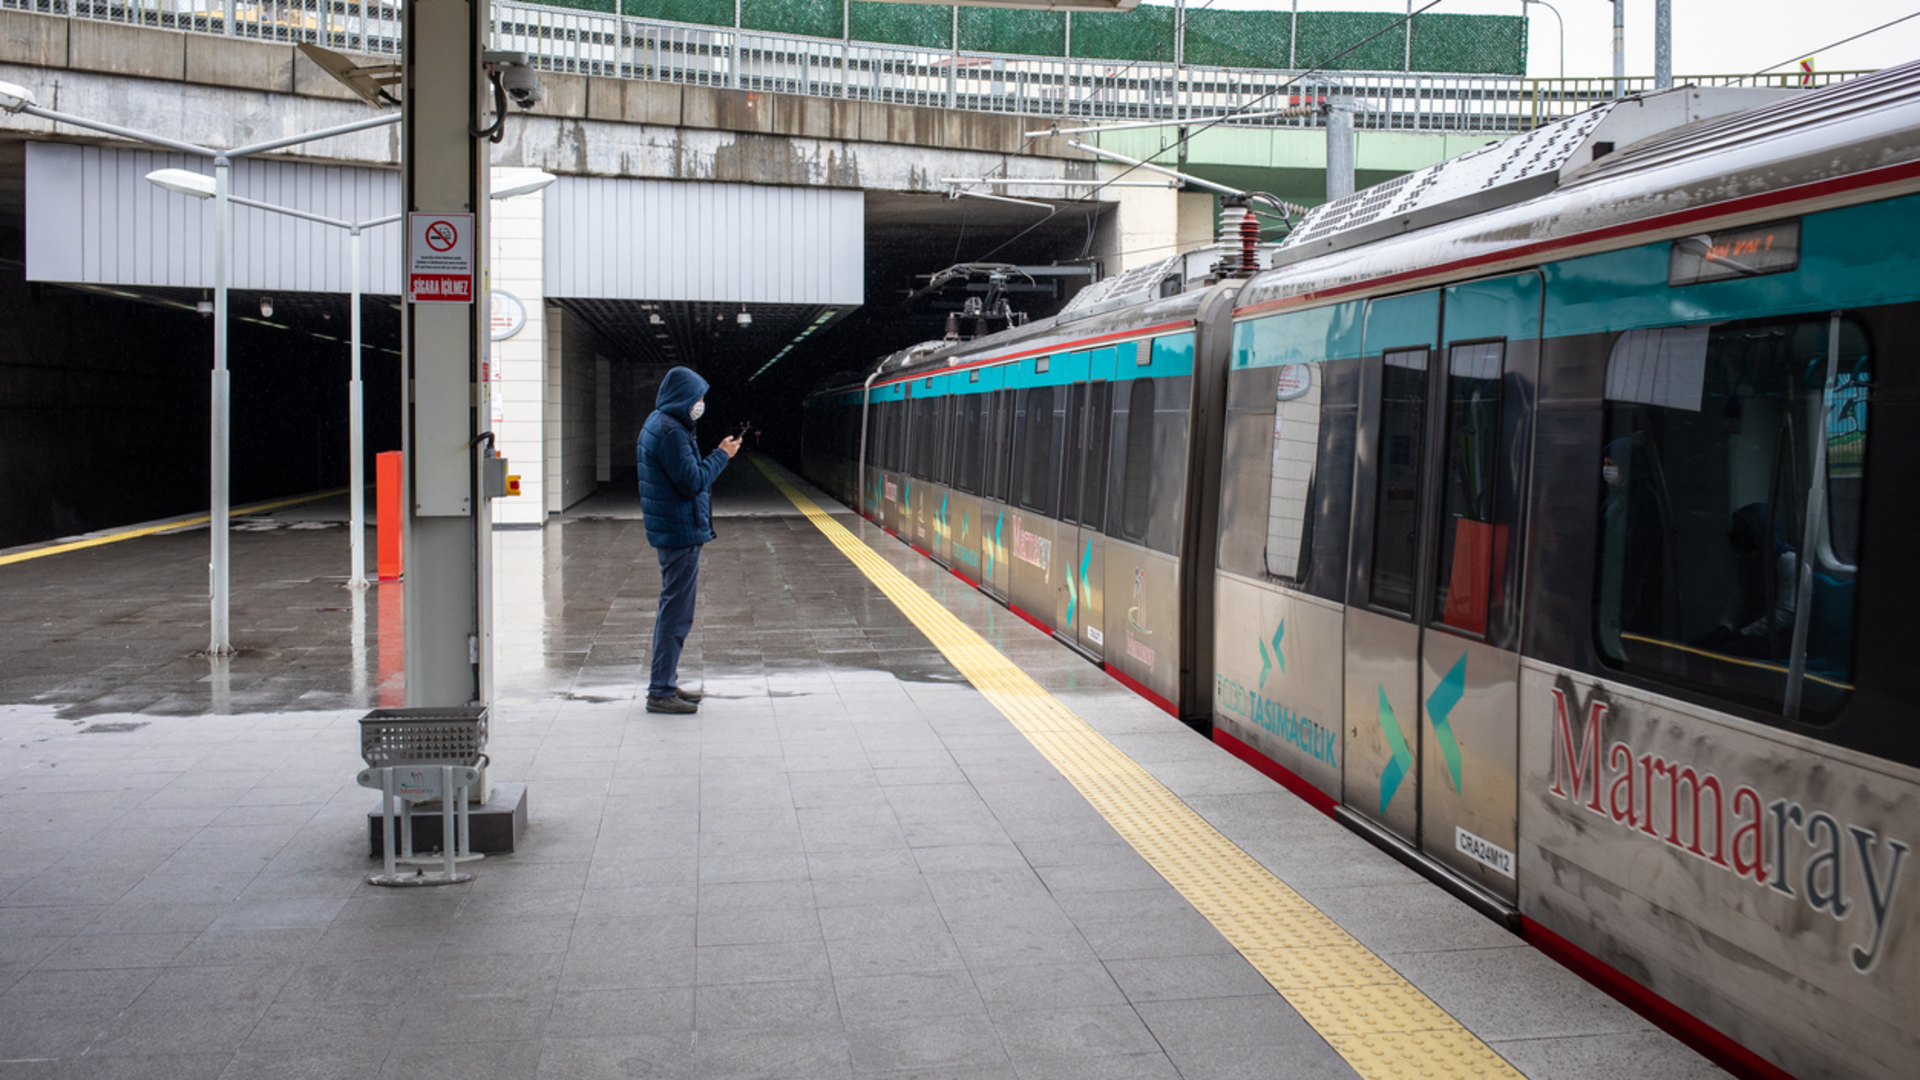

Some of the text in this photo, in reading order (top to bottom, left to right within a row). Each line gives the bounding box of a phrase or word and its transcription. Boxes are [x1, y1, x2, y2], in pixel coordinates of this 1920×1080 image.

[413, 277, 468, 297] SİGARA İÇİLMEZ
[1249, 690, 1337, 769] TAŞIMACILIK
[1460, 833, 1510, 873] CRA24M12
[1550, 686, 1911, 974] Marmaray
